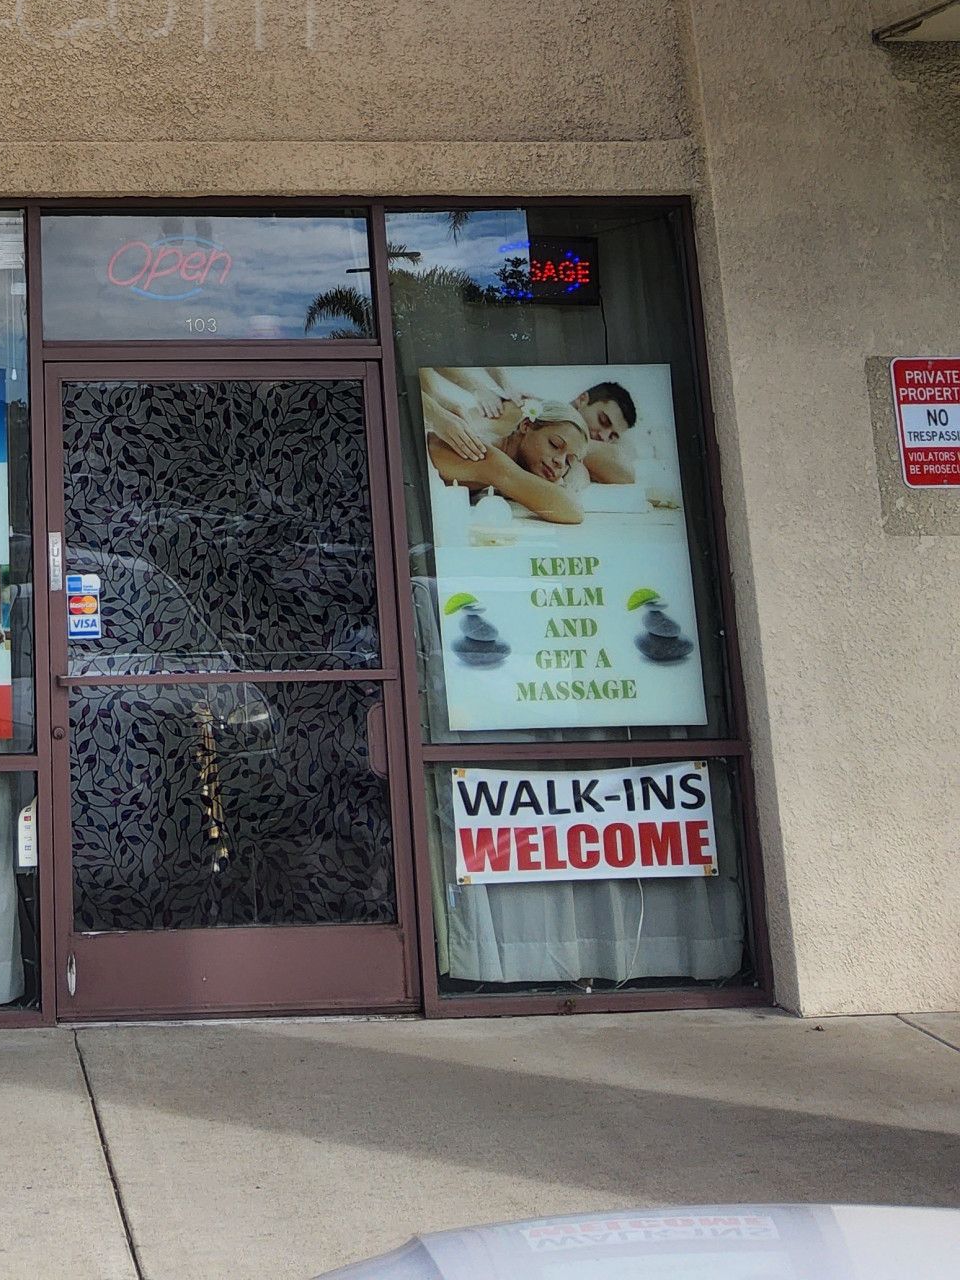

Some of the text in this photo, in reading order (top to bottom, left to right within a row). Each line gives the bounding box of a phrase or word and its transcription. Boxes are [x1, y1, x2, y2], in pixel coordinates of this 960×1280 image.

[107, 240, 233, 290] Open
[185, 318, 217, 333] 103
[905, 370, 960, 384] PRIVATE
[900, 387, 960, 401] PROPERT
[927, 409, 949, 426] NO
[908, 451, 956, 462] VIOLATORS
[910, 466, 921, 475] BE
[529, 556, 600, 577] KEEP
[530, 587, 604, 607] CALM
[74, 619, 97, 628] VISA
[544, 618, 598, 638] AND
[535, 648, 612, 670] GET A
[516, 679, 637, 701] MASSAGE
[457, 773, 707, 816] WALK-INS
[459, 820, 713, 872] WELCOME
